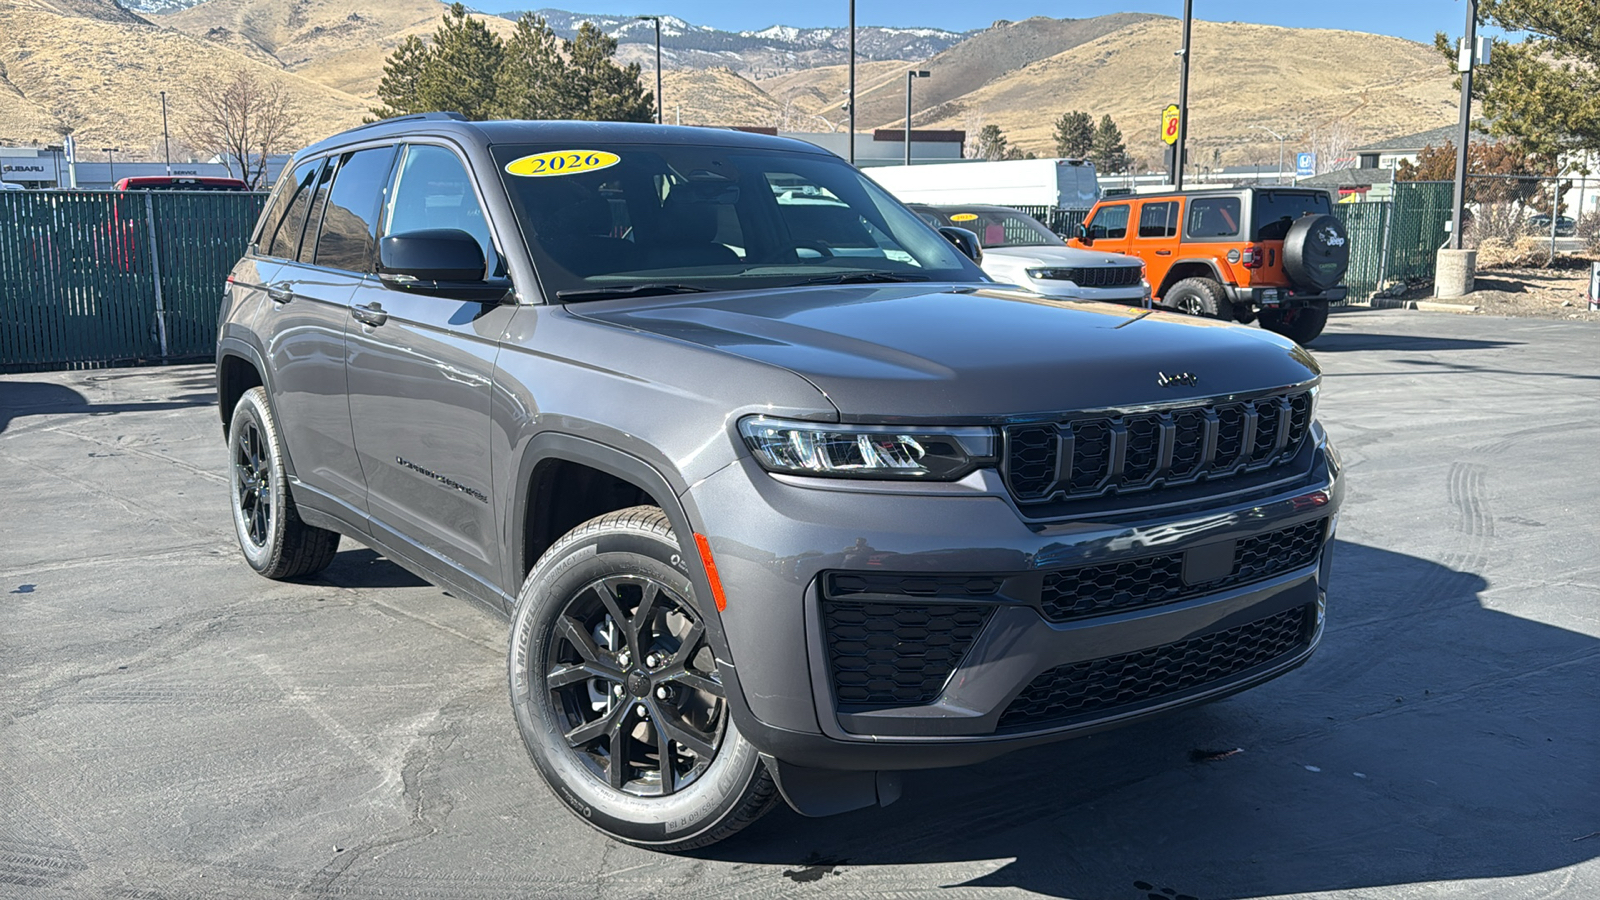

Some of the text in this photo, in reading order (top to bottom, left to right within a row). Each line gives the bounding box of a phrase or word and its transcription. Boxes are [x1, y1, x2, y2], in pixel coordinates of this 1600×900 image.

[1166, 117, 1178, 136] 8
[531, 153, 600, 174] 2026
[1327, 236, 1345, 247] Jeep
[545, 555, 577, 583] PRIMACY
[688, 797, 716, 822] 265/60
